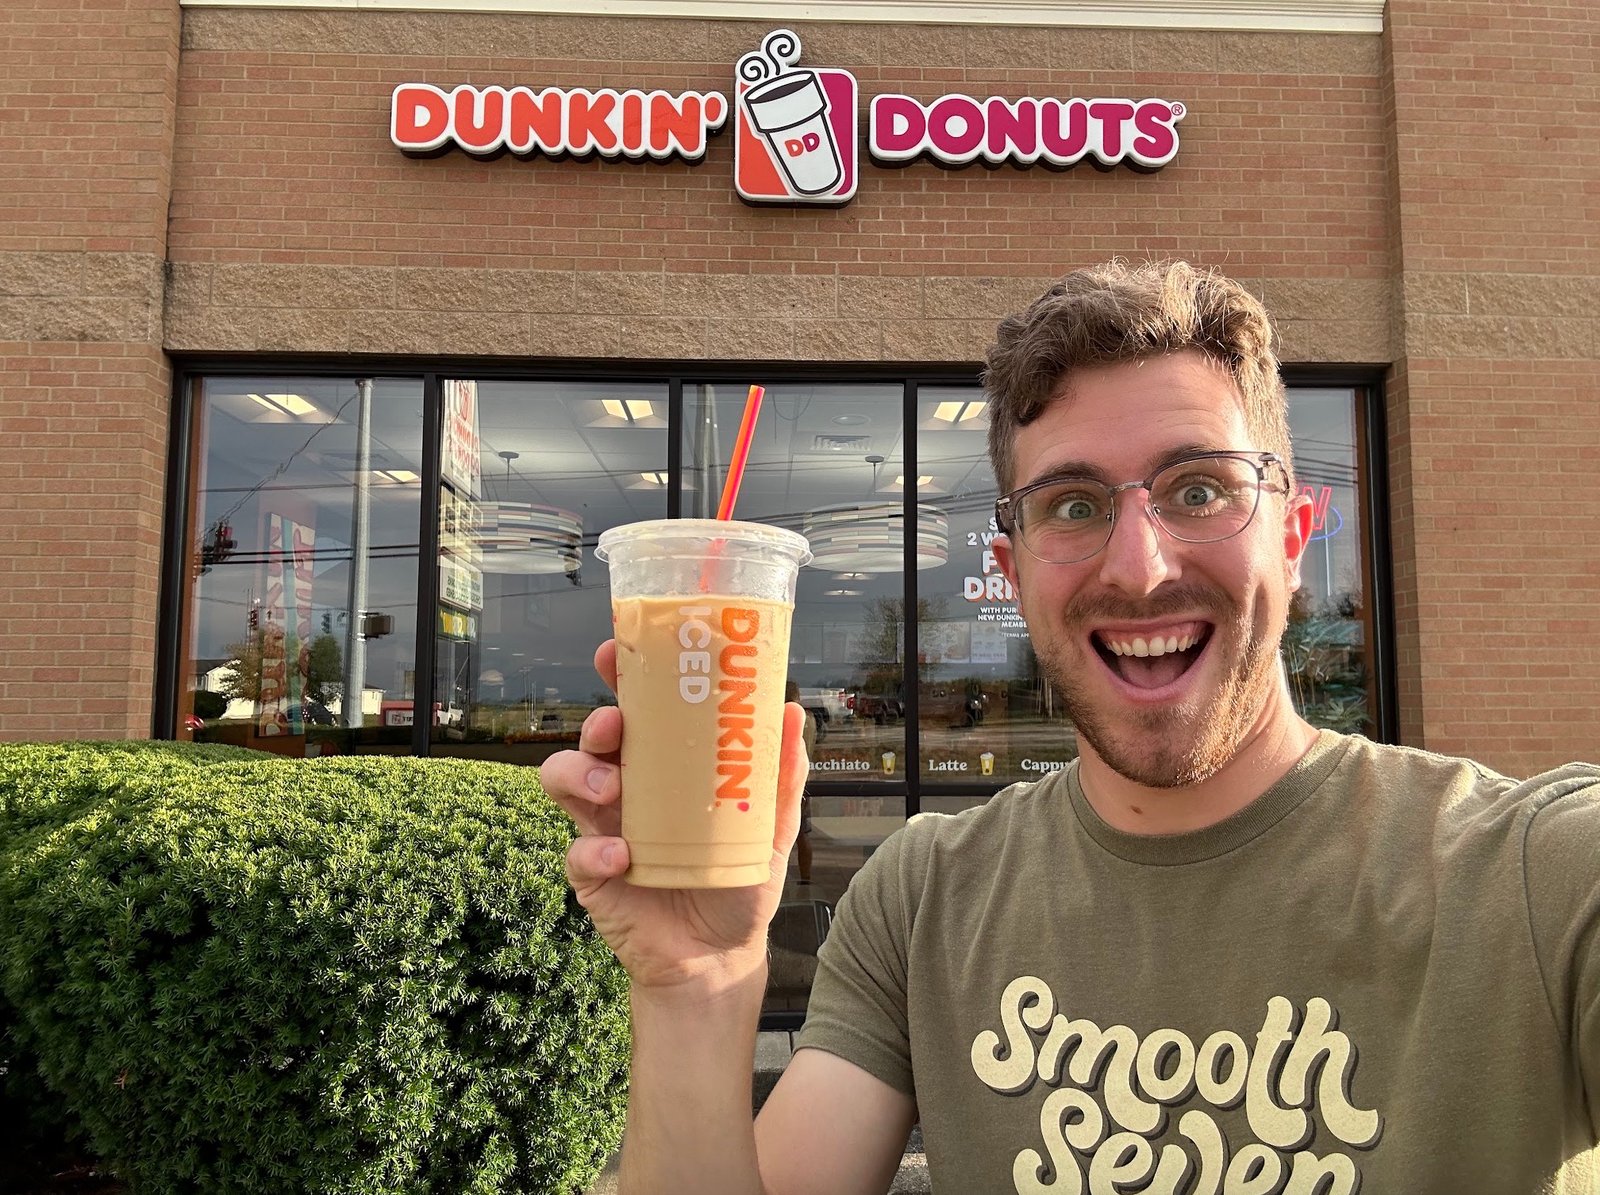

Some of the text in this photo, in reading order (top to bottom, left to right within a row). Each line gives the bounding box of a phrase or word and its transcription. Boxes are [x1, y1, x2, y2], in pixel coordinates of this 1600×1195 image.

[395, 88, 722, 152] DUNKIN'
[784, 132, 820, 157] DD
[964, 576, 1018, 600] DRI
[678, 606, 713, 704] ICED
[808, 758, 870, 771] acchiato
[928, 759, 968, 771] Latte
[1021, 758, 1069, 773] Cappu
[970, 975, 1381, 1147] Smooth
[1012, 1087, 1359, 1195] Seven
